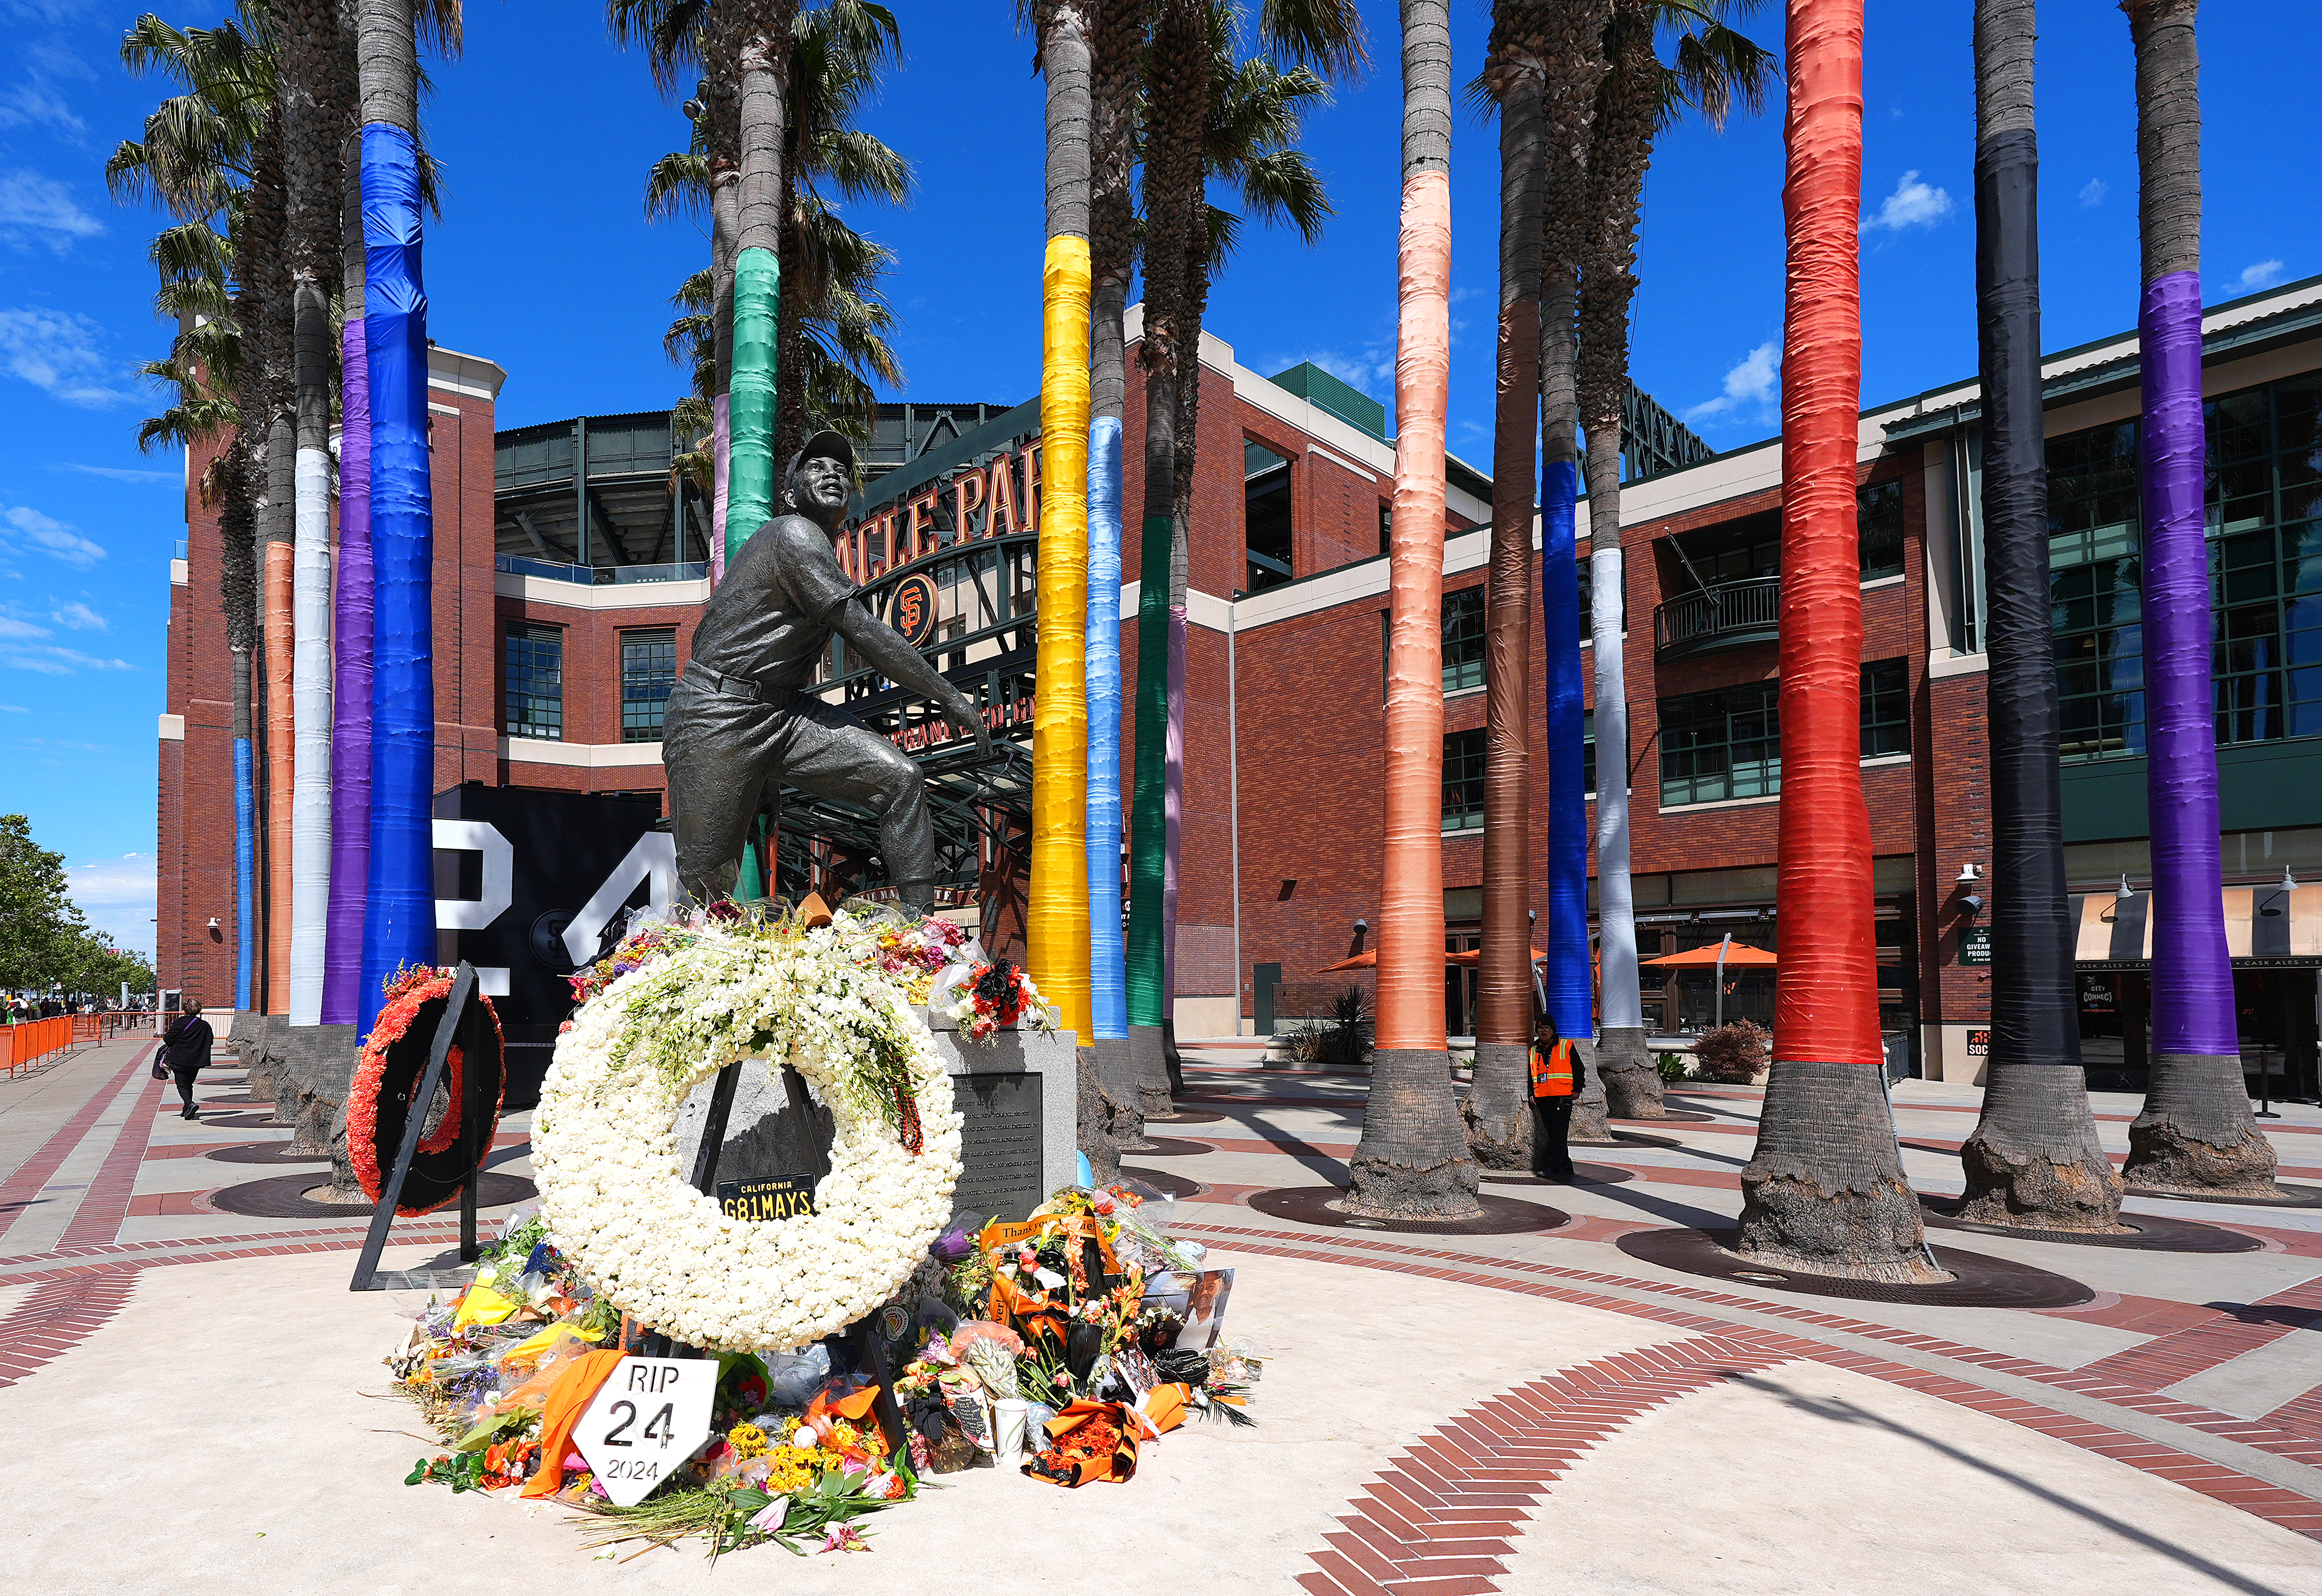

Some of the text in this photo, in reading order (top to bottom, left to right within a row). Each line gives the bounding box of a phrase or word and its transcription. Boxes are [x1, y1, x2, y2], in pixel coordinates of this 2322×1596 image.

[835, 487, 939, 588] ACLE
[2084, 992, 2112, 1002] CONNECT
[1969, 1045, 1990, 1054] SOC
[741, 1181, 792, 1194] CALIFORNIA
[724, 1191, 811, 1221] G81MAYS
[1003, 1225, 1032, 1238] Thank
[996, 1299, 1004, 1324] ver!
[627, 1365, 679, 1393] RIP
[603, 1400, 675, 1449] 24
[606, 1459, 658, 1481] 2024
